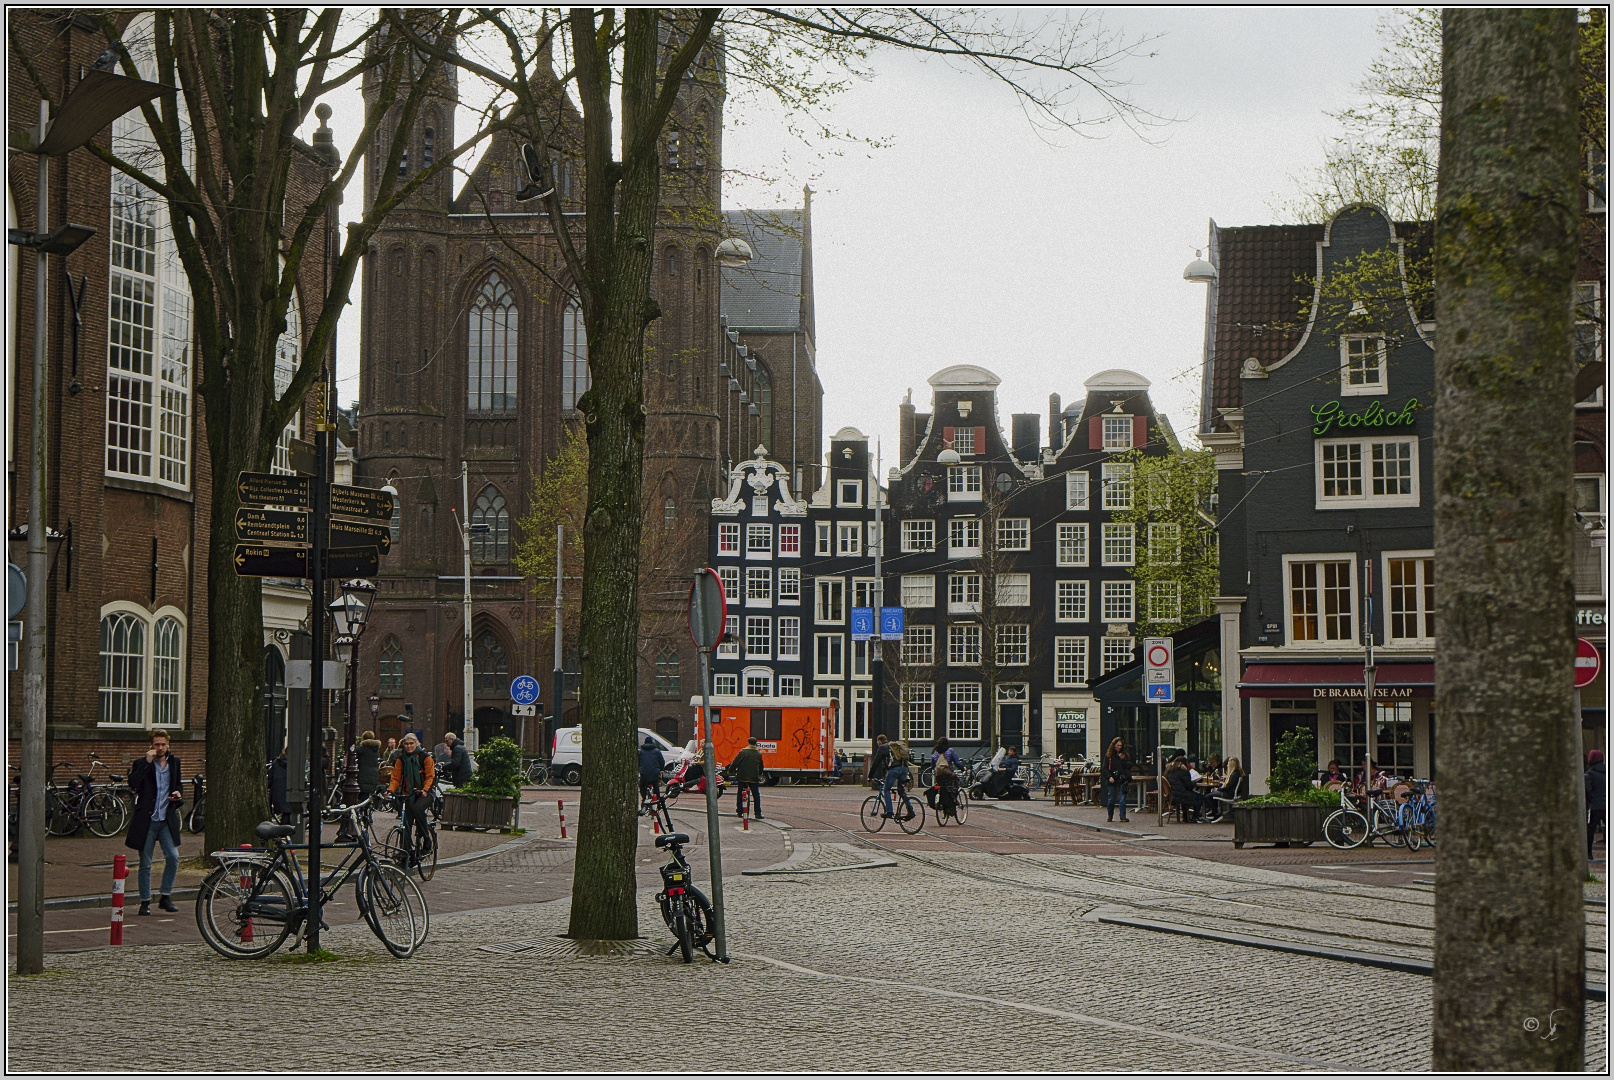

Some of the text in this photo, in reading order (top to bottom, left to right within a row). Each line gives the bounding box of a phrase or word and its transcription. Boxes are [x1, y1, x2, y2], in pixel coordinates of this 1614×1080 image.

[1310, 398, 1418, 435] Grolsch
[260, 486, 283, 494] Collecties
[332, 487, 349, 496] Bijbels
[349, 490, 370, 499] Museum
[332, 496, 360, 505] Westerkerk
[247, 512, 260, 520] Dam
[247, 521, 290, 530] Rembrandtplein
[331, 523, 343, 531] Huis
[343, 524, 368, 534] Marseille
[270, 530, 290, 538] Station
[245, 548, 263, 556] Rokin
[1575, 609, 1606, 625] ffe
[1313, 688, 1327, 698] DE
[1390, 688, 1413, 698] AAP
